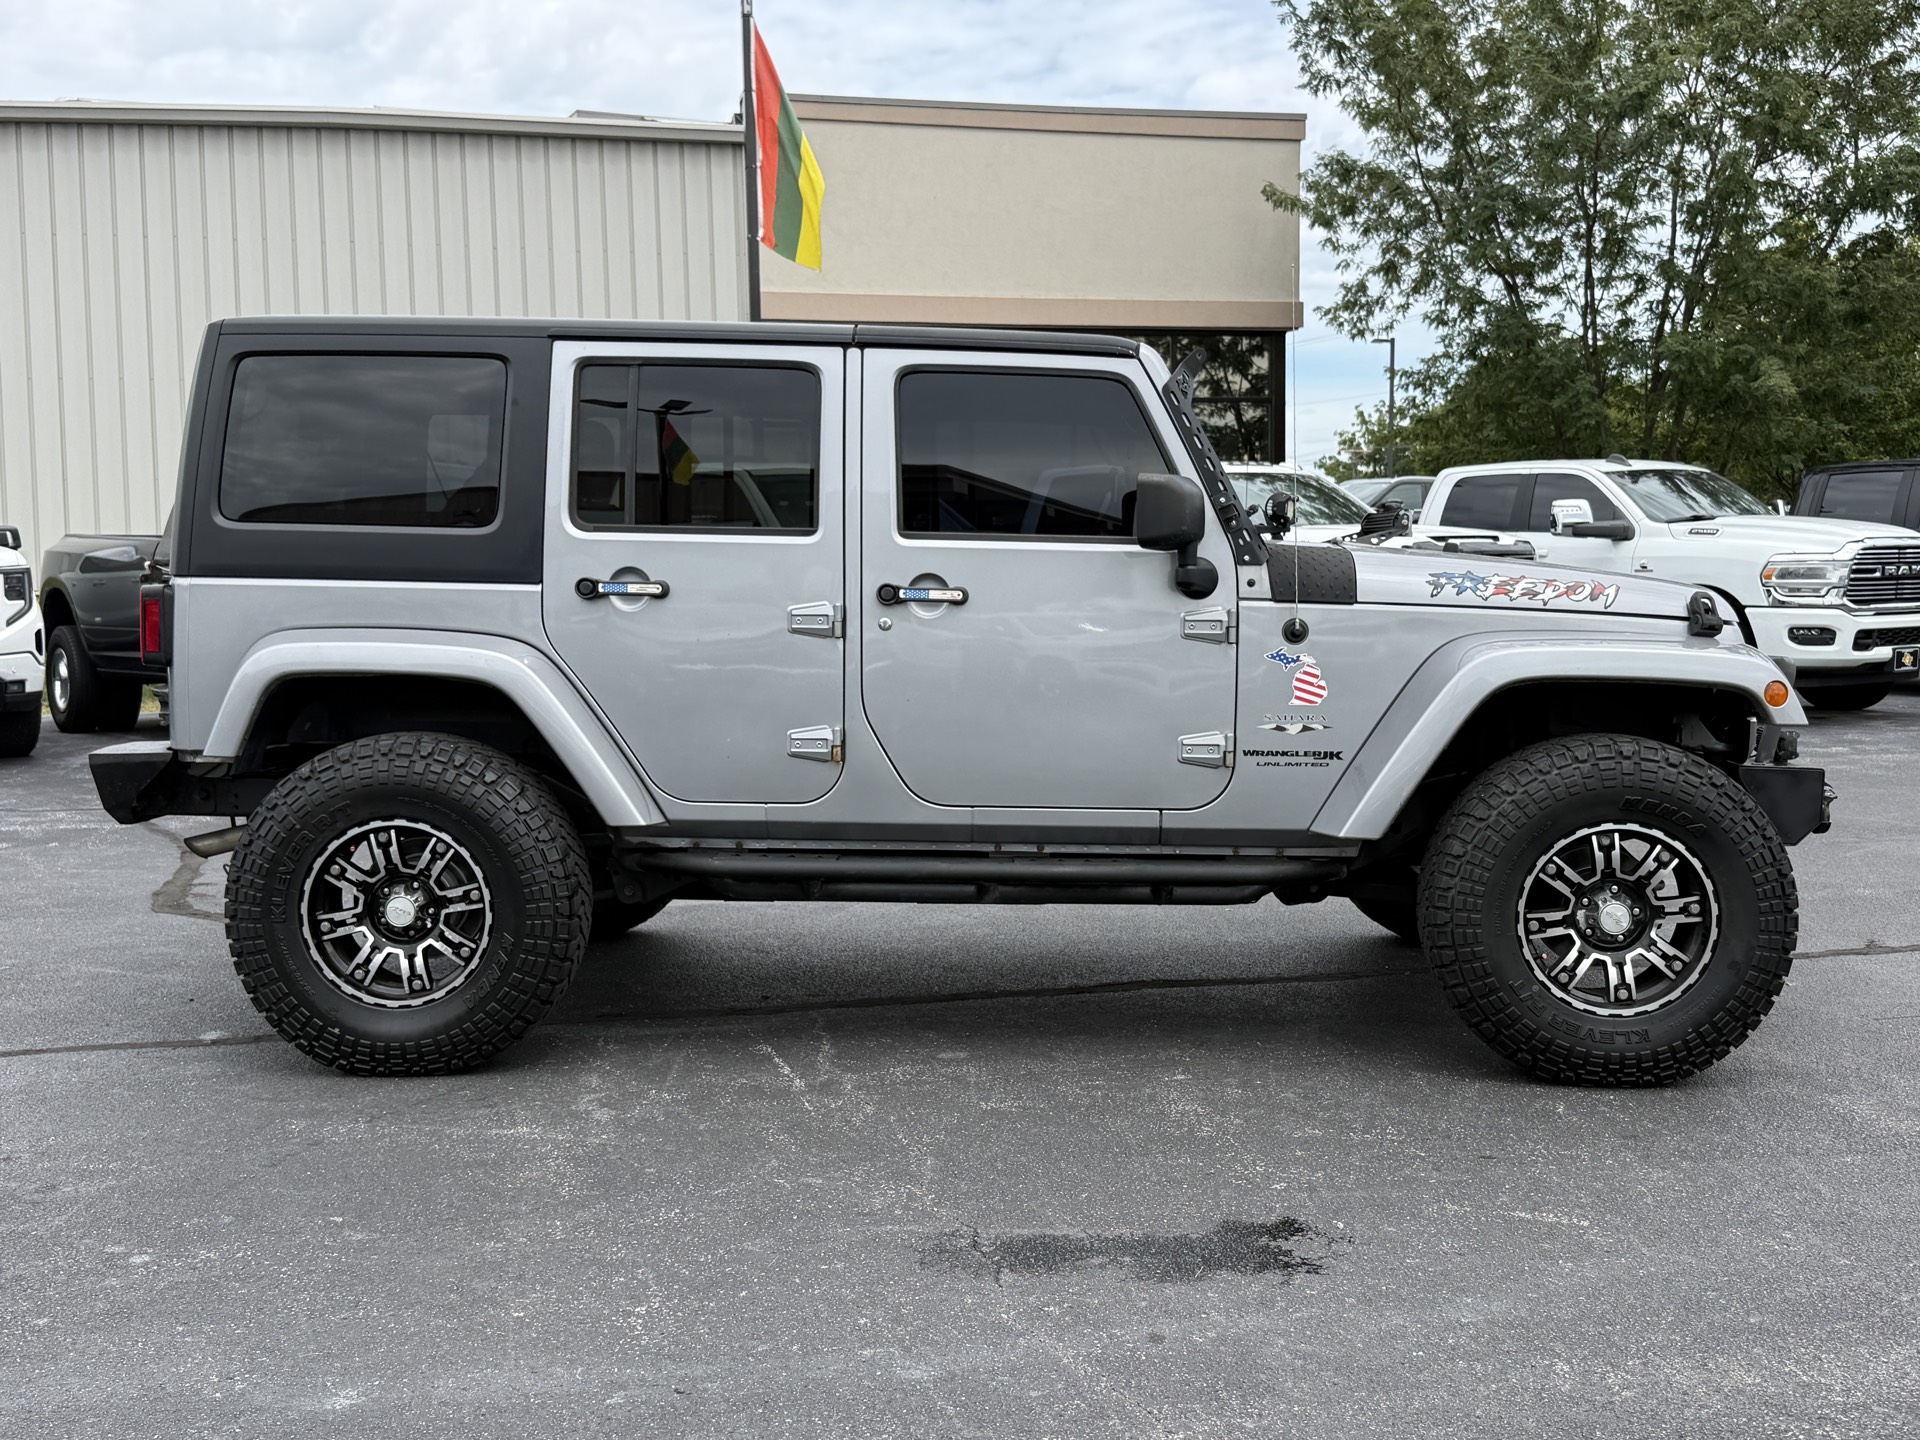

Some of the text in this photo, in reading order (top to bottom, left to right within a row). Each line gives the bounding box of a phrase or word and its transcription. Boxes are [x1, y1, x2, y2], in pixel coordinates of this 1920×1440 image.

[1425, 570, 1620, 609] FREEDOM
[1619, 795, 1707, 839] KENDA
[270, 830, 316, 924] KLEVER
[463, 932, 515, 1009] KENDA
[1547, 1012, 1651, 1045] KLEVER
